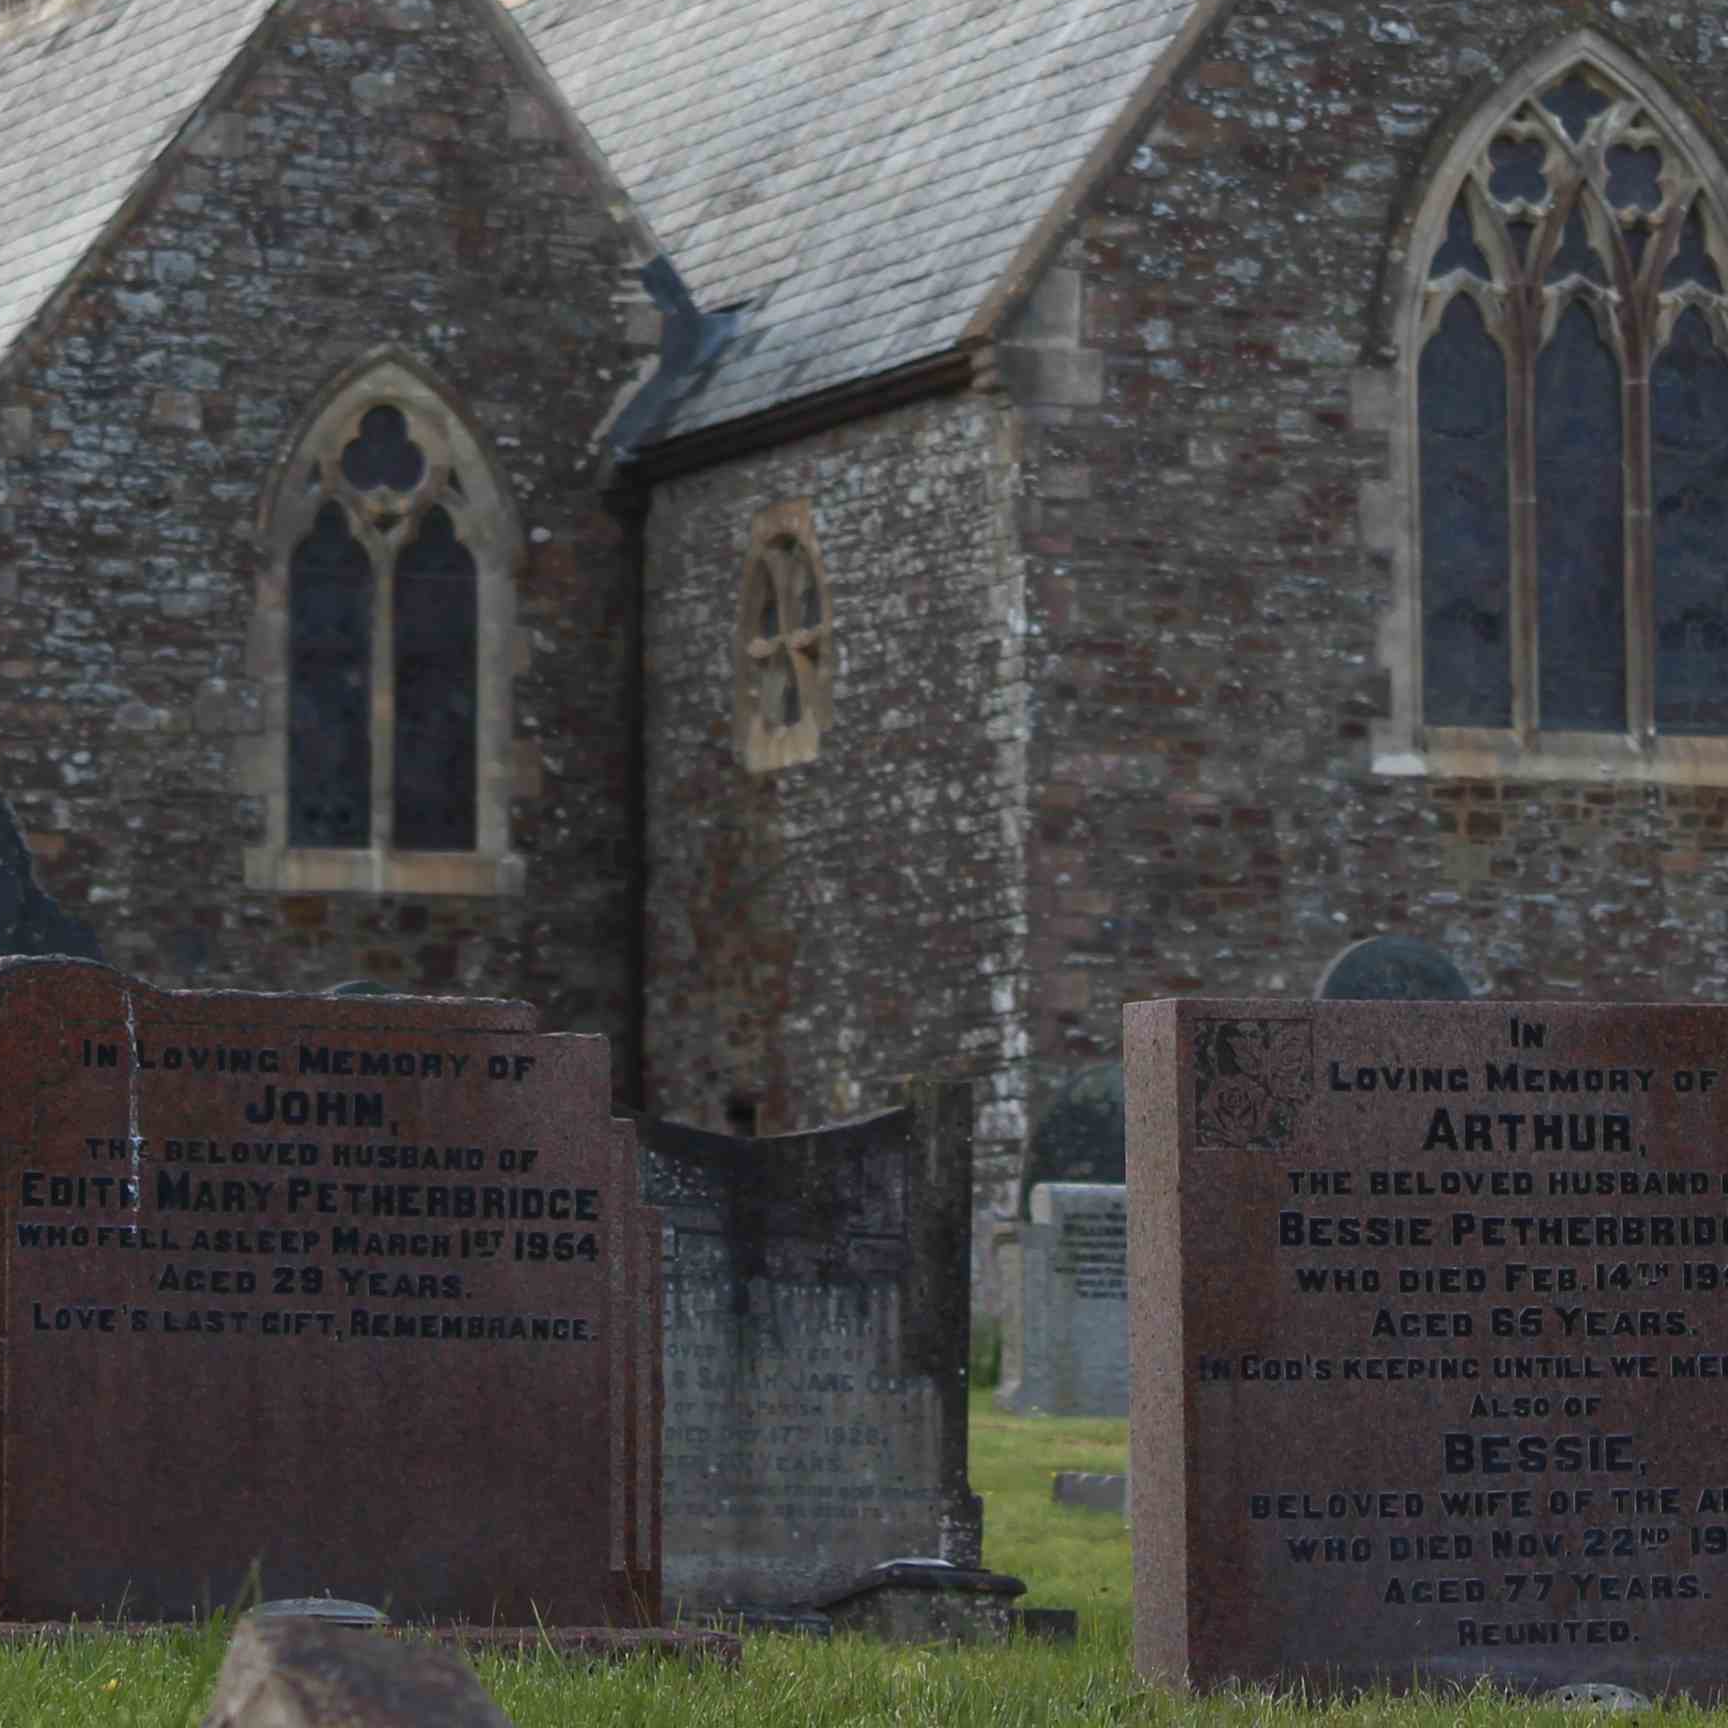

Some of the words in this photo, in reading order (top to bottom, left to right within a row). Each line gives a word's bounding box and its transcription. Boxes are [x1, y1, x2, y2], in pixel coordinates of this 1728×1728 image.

[1509, 1018, 1545, 1049] IN
[82, 1039, 118, 1068] IN
[136, 1041, 280, 1073] LOVING
[298, 1045, 471, 1078] MEMORY
[487, 1055, 536, 1081] OF
[1329, 1061, 1470, 1094] LOVING
[1485, 1062, 1655, 1095] MEMORY
[1673, 1068, 1720, 1096] OF
[246, 1084, 400, 1135] JOHN,
[1423, 1108, 1648, 1158] ARTHUR,
[166, 1139, 319, 1168] BELOVED
[333, 1144, 482, 1172] HUSBAND
[498, 1147, 538, 1172] OF
[157, 1171, 271, 1214] MARY
[287, 1177, 600, 1223] PETHERBRIDGE
[1289, 1172, 1353, 1196] THE
[1371, 1172, 1533, 1197] BELOVED
[1547, 1172, 1709, 1197] HUSBAND
[17, 1223, 90, 1249] WHO
[97, 1224, 180, 1250] FELL
[192, 1230, 321, 1256] ASLEEP
[332, 1226, 451, 1258] MARCH
[1280, 1210, 1432, 1248] BESSIE
[157, 1264, 256, 1295] AGED
[272, 1266, 323, 1296] 29
[342, 1269, 472, 1299] YEARS.
[1297, 1267, 1380, 1294] WHO
[1398, 1266, 1486, 1294] DIED
[32, 1302, 148, 1333] LOVE'S
[163, 1308, 248, 1334] LAST
[1373, 1309, 1471, 1337] AGED
[1491, 1308, 1544, 1337] 65
[1555, 1306, 1698, 1338] YEARS.
[1199, 1355, 1235, 1381] IN
[1240, 1355, 1332, 1380] GOD'S
[1343, 1356, 1479, 1381] KEEPING
[1493, 1356, 1601, 1379] UNTILL
[1610, 1356, 1658, 1379] WE
[1471, 1394, 1549, 1418] ALSO
[1564, 1394, 1602, 1418] OF
[1443, 1433, 1650, 1476] BESSIE,
[1250, 1492, 1423, 1520] BELOVED
[1440, 1489, 1533, 1518] WIFE
[1548, 1488, 1592, 1516] OF
[1611, 1488, 1682, 1516] THE
[1287, 1536, 1372, 1563] WHO
[1390, 1533, 1473, 1562] DIED
[1491, 1529, 1571, 1560] NOV.
[1384, 1578, 1485, 1606] AGED
[1503, 1575, 1552, 1603] 77
[1572, 1574, 1713, 1603] YEARS.
[1457, 1618, 1641, 1648] REUNITED.
